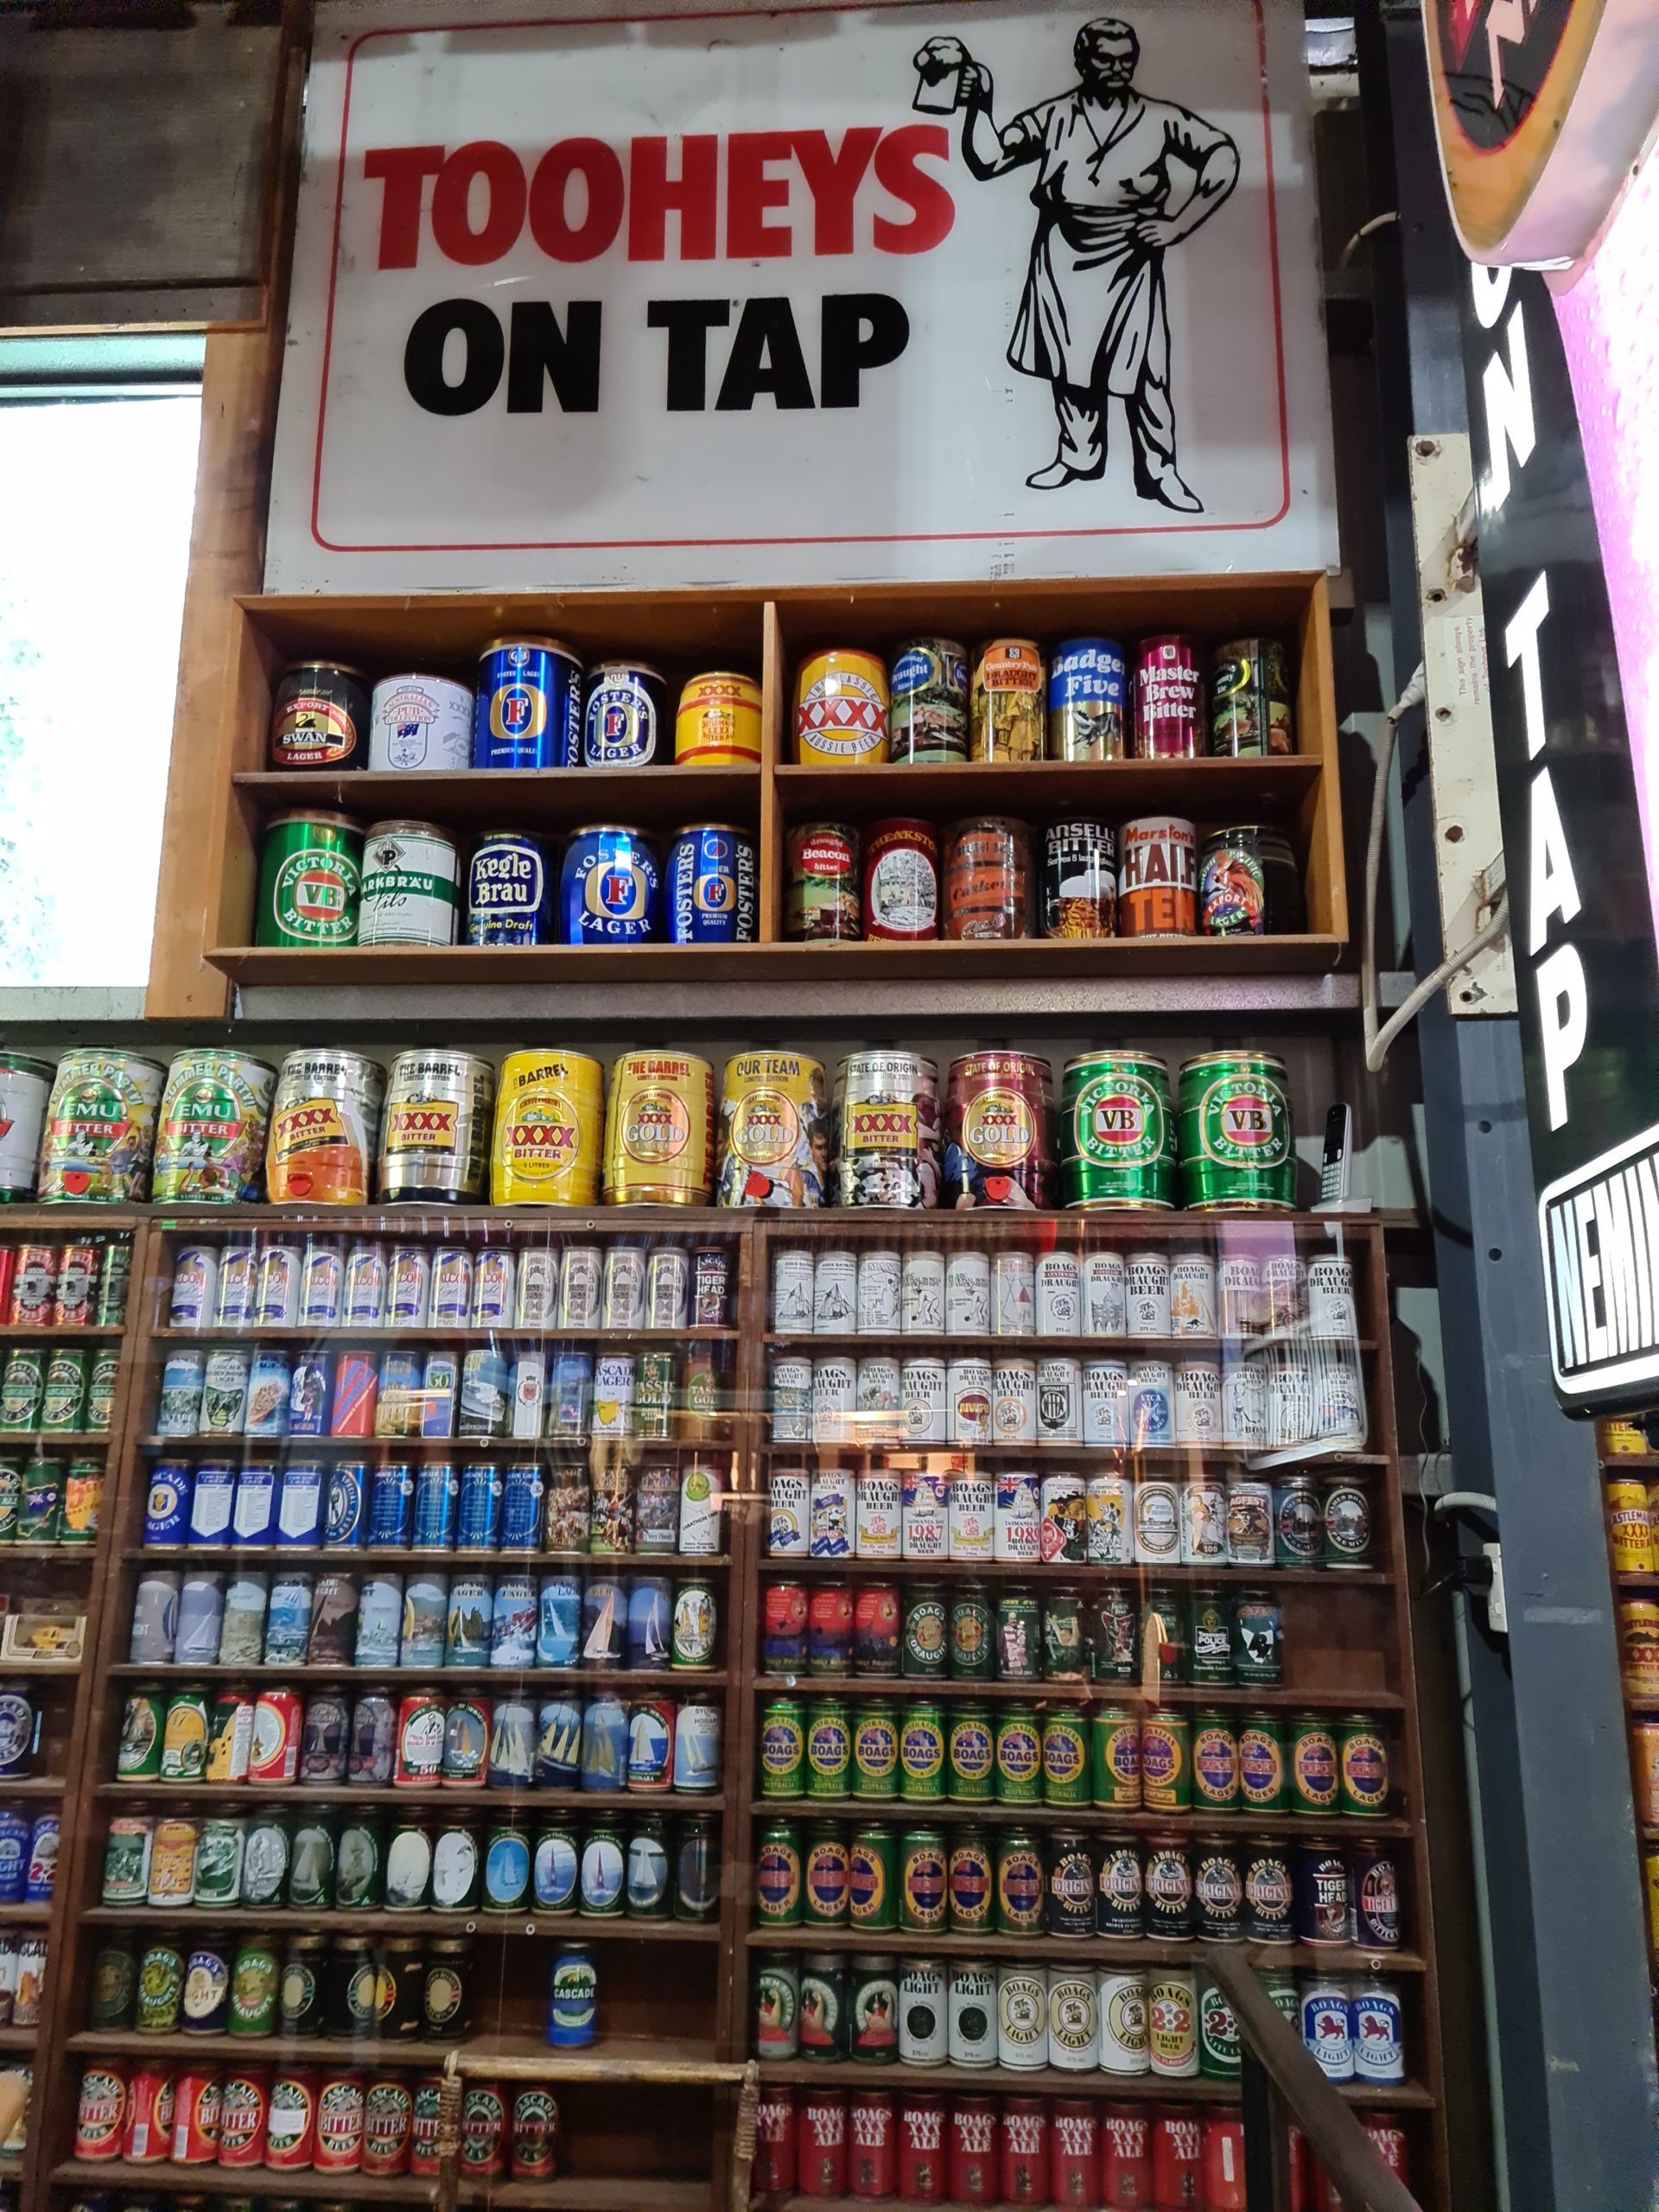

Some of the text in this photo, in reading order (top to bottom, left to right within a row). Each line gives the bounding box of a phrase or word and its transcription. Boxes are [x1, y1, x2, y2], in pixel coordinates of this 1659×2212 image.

[363, 124, 956, 270] TOOHEYS
[403, 292, 910, 416] ON TAP
[1466, 618, 1476, 652] property
[986, 660, 1021, 671] Country
[986, 671, 1038, 681] DRAUGHT
[991, 677, 1033, 688] BITTER
[1139, 665, 1200, 687] Master
[697, 685, 741, 697] XXXX
[1065, 675, 1119, 697] Five
[1146, 684, 1195, 702] Brew
[1471, 673, 1480, 704] remains
[286, 698, 329, 714] EXPORT
[388, 692, 434, 709] AUSTRALIAN
[588, 691, 649, 721] FOSTER'S
[386, 713, 431, 722] COLLECTION
[397, 706, 420, 716] PUB
[506, 697, 529, 725] F
[798, 699, 887, 734] XXXX
[1143, 702, 1196, 721] Bitter
[605, 713, 623, 736] F
[283, 732, 327, 745] SWAN
[810, 735, 846, 753] AUSSIE
[287, 751, 322, 760] LAGER
[590, 743, 643, 760] LAGER
[1125, 825, 1195, 844] Marston's
[1048, 837, 1115, 855] BITTER
[1506, 570, 1589, 1133] TAP
[802, 849, 850, 862] Beacon
[474, 852, 531, 880] Kegle
[575, 848, 658, 890] FOSER'S
[814, 862, 838, 871] bitter
[1125, 844, 1196, 887] HALF
[1229, 850, 1261, 880] PACIFIC
[282, 856, 355, 896] VICTORIA
[361, 875, 434, 893] ARKBRÄU
[302, 884, 342, 907] VB
[475, 882, 527, 906] Brau
[606, 875, 633, 905] F
[676, 843, 695, 944] FOSTER'S
[736, 844, 753, 943] FOSTER'S
[1129, 887, 1196, 931] TEN
[1207, 893, 1248, 914] EXPORT
[283, 908, 353, 934] BITTER
[577, 910, 652, 935] LAGER
[1211, 906, 1246, 927] LAGER
[469, 919, 533, 934] Genuine Draft
[398, 1062, 462, 1077] THE BARREL
[518, 1063, 569, 1087] BARREL
[627, 1061, 690, 1077] THE BARREL
[736, 1059, 800, 1077] OUR TEAM
[849, 1064, 869, 1075] STATE
[887, 1063, 918, 1075] ORIGIN
[964, 1062, 1035, 1076] STATE OF ORIGIN
[166, 1063, 257, 1107] SUMMER PARTY!
[1080, 1081, 1155, 1116] VICTORIA
[1208, 1082, 1282, 1117] VICTORIA
[63, 1103, 117, 1117] EMU
[179, 1103, 231, 1118] EMU
[277, 1108, 336, 1140] XXXX
[392, 1113, 452, 1132] XXXX
[638, 1113, 672, 1124] XXXX
[747, 1115, 781, 1125] XXXX
[852, 1114, 912, 1134] XXXX
[982, 1115, 1017, 1125] XXXX
[1100, 1109, 1136, 1130] VB
[1229, 1109, 1268, 1130] VB
[60, 1124, 113, 1135] BITTER
[175, 1123, 227, 1135] BITTER
[289, 1127, 326, 1141] BITTER
[401, 1133, 435, 1141] BITTER
[505, 1125, 575, 1148] XXXX
[626, 1123, 684, 1143] GOLD
[734, 1124, 793, 1144] GOLD
[969, 1125, 1030, 1144] GOLD
[862, 1135, 899, 1143] BITTER
[1085, 1135, 1155, 1158] BITTER
[514, 1149, 562, 1159] BITTER
[1213, 1135, 1284, 1160] BITTER
[1128, 1266, 1166, 1276] BOAGS
[696, 1275, 726, 1285] TIGER
[696, 1285, 725, 1295] HEAD
[1130, 1285, 1165, 1295] BEER
[1084, 1371, 1123, 1381] BOAGS
[636, 1392, 672, 1404] GOLD
[860, 1480, 899, 1491] BOAGS
[952, 1483, 991, 1492] BOAGS
[1230, 1497, 1266, 1507] AGFEST
[907, 1525, 944, 1541] 1987
[910, 1639, 948, 1664] DRAUGHT
[1200, 1732, 1233, 1746] BOAGS
[811, 1745, 849, 1756] BOAGS
[858, 1745, 895, 1757] BOAGS
[903, 1746, 940, 1758] BOAGS
[953, 1748, 991, 1760] BOAGS
[1000, 1750, 1039, 1762] BOAGS
[1204, 1783, 1236, 1799] LAGER
[1200, 1858, 1237, 1872] BOAGS
[1316, 1878, 1347, 1891] TIGER
[1318, 1891, 1348, 1904] HEAD
[553, 1987, 595, 1999] CASCADE
[904, 1982, 940, 1994] LIGHT
[1309, 1999, 1348, 2013] BOAGS
[1315, 2048, 1349, 2062] LIGHT
[321, 2113, 363, 2134] BITTER
[854, 2119, 885, 2133] XXX
[855, 2133, 885, 2146] ALE
[1112, 2131, 1145, 2145] XXX
[1114, 2145, 1144, 2158] ALE
